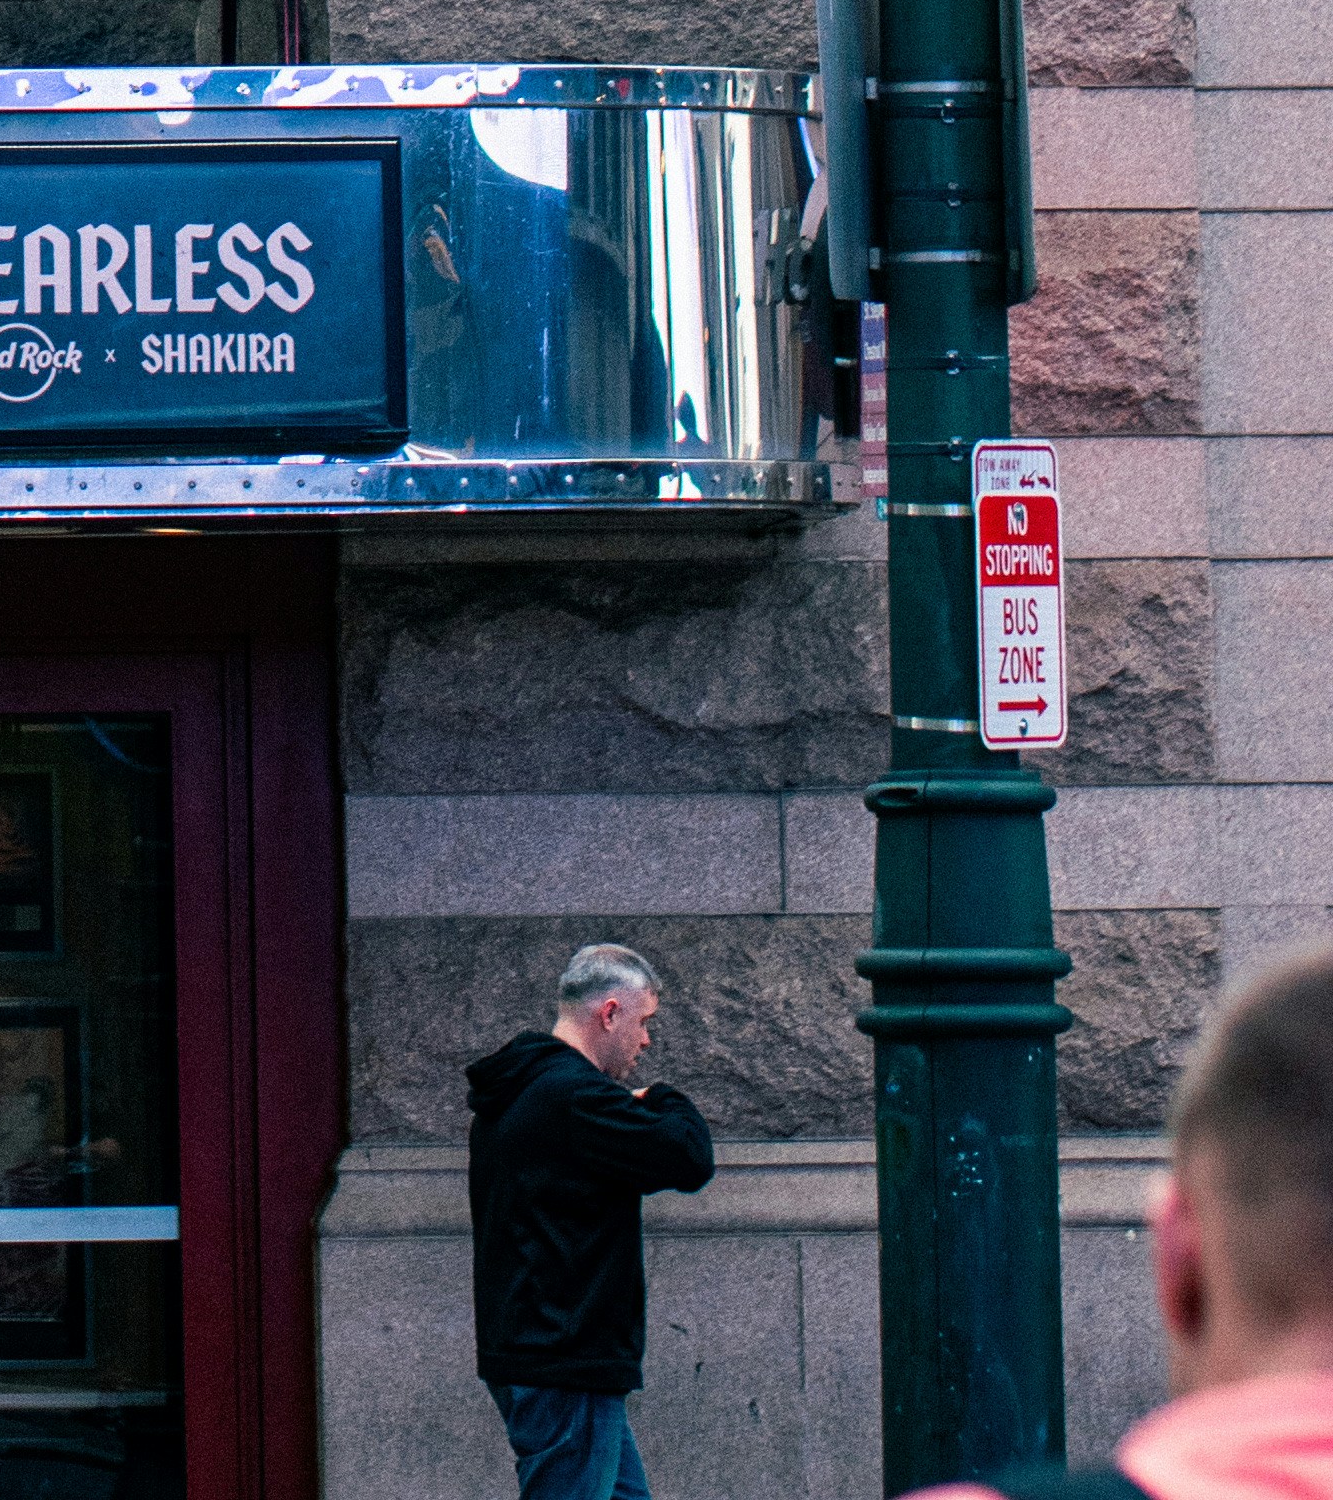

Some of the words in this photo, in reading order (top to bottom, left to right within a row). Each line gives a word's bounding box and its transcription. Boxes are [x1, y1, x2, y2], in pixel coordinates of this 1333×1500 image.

[20, 342, 82, 373] Rock
[142, 332, 295, 373] SHAKIRA
[979, 458, 995, 472] TOW
[1000, 458, 1020, 471] AWAY
[991, 477, 1010, 490] ZONE
[1007, 502, 1028, 536] NO
[986, 545, 1053, 576] STOPPING
[1003, 599, 1038, 635] BUS
[999, 647, 1046, 684] ZONE
